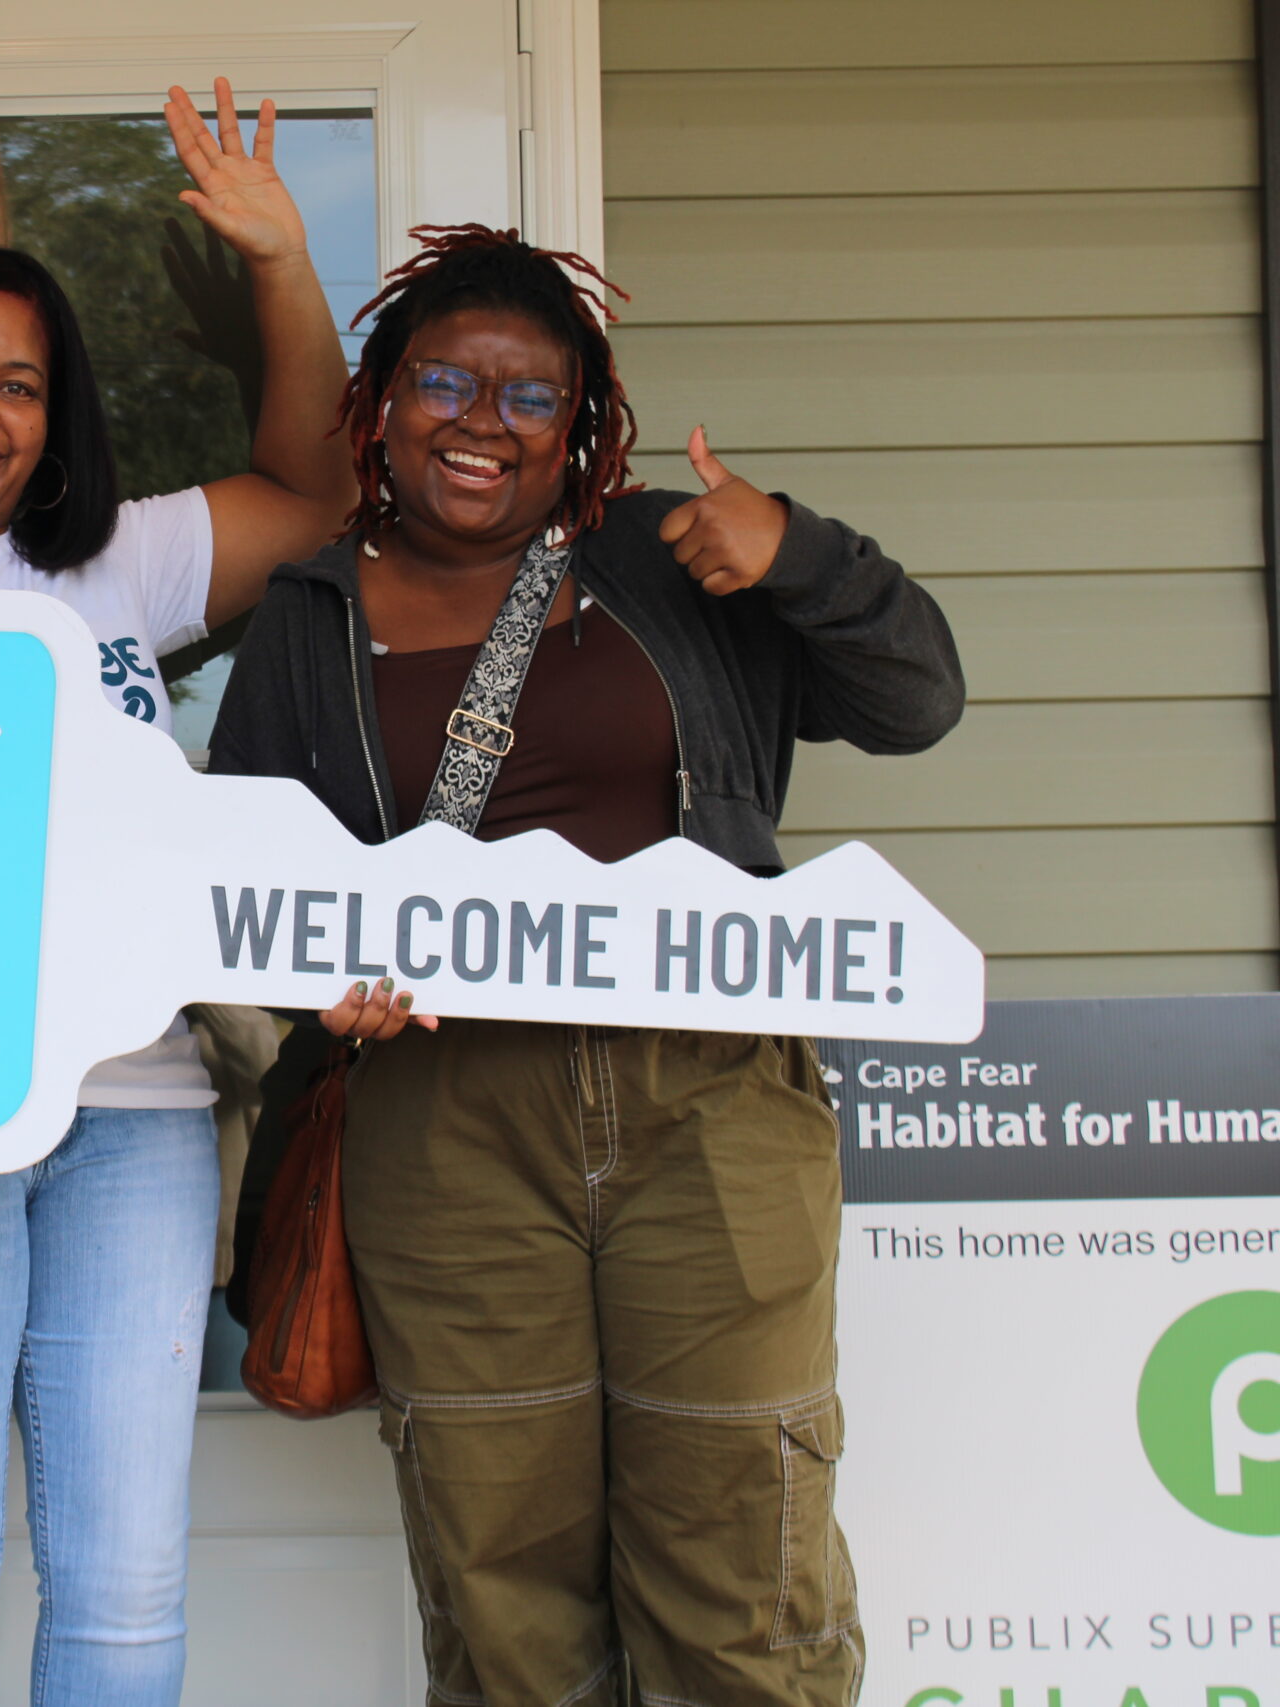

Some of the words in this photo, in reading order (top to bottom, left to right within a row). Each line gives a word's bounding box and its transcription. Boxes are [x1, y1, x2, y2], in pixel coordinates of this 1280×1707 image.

[209, 884, 619, 989] WELCOME
[654, 907, 905, 1005] HOME!
[856, 1057, 947, 1094] Cape
[959, 1056, 1038, 1087] Fear
[856, 1100, 1048, 1149] Habitat
[1061, 1101, 1133, 1146] for
[1146, 1099, 1280, 1144] Huma
[862, 1226, 944, 1259] This
[958, 1226, 1065, 1258] home
[1078, 1228, 1155, 1256] was
[1169, 1228, 1280, 1263] gener
[907, 1615, 1113, 1651] PUBLIX
